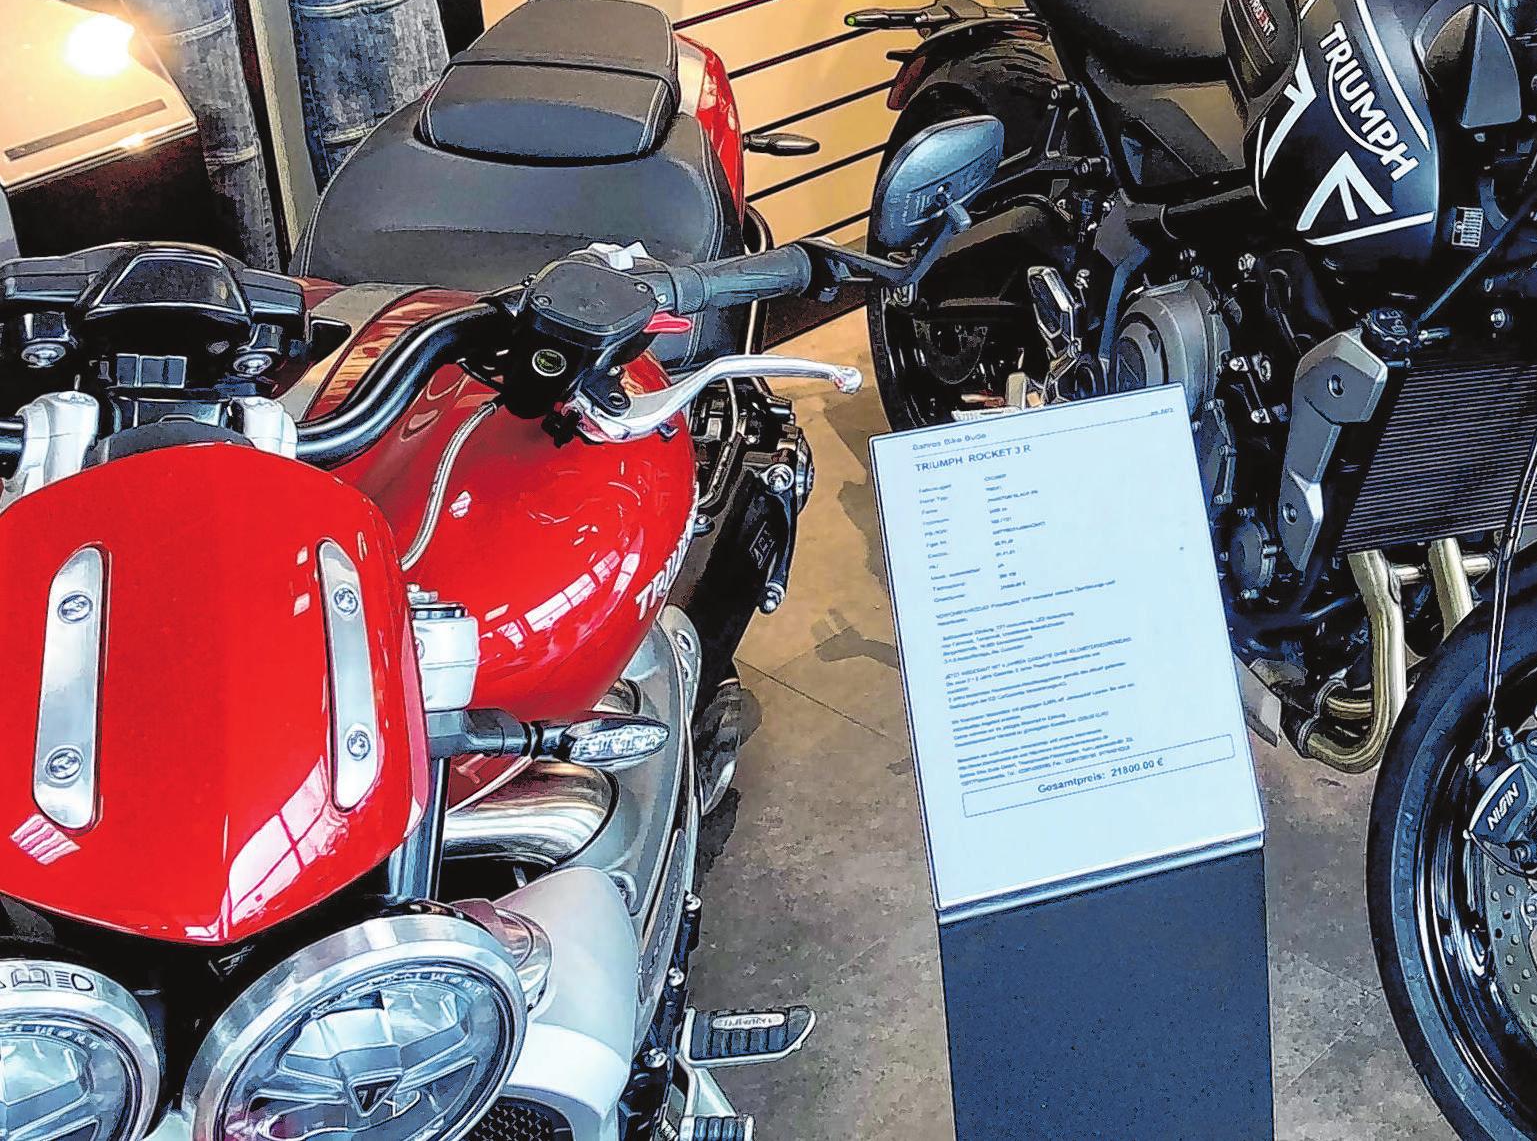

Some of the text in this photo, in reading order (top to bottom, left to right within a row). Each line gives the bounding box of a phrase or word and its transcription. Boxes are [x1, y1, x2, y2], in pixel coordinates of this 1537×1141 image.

[1319, 21, 1419, 182] TRIUMPH
[915, 456, 963, 472] TRIUMPH
[968, 447, 1012, 463] ROCKET
[1023, 444, 1031, 454] R
